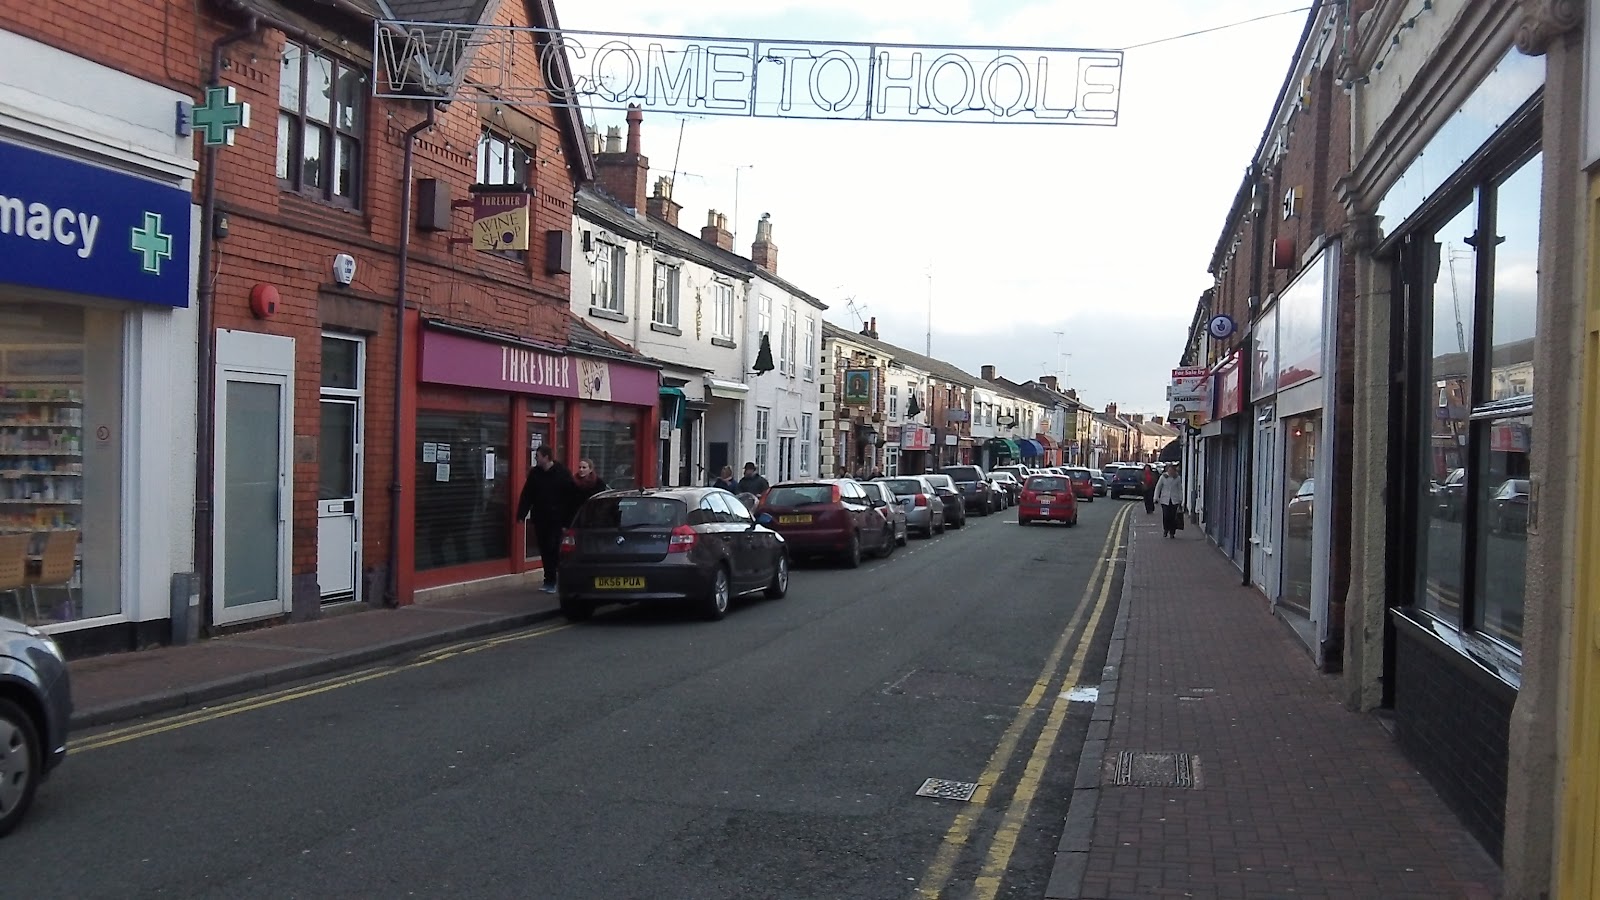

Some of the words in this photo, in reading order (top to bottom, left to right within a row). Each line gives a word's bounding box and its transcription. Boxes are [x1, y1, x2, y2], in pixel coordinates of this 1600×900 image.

[379, 27, 749, 109] WELCOME
[768, 48, 859, 112] TO
[876, 51, 1119, 118] HOOLE
[481, 196, 520, 206] THRESHER
[479, 212, 518, 233] WINE
[481, 226, 521, 247] SHOP
[501, 346, 570, 388] THRESHER
[581, 360, 603, 375] WINE
[598, 577, 621, 587] DK56
[623, 577, 641, 587] PUA
